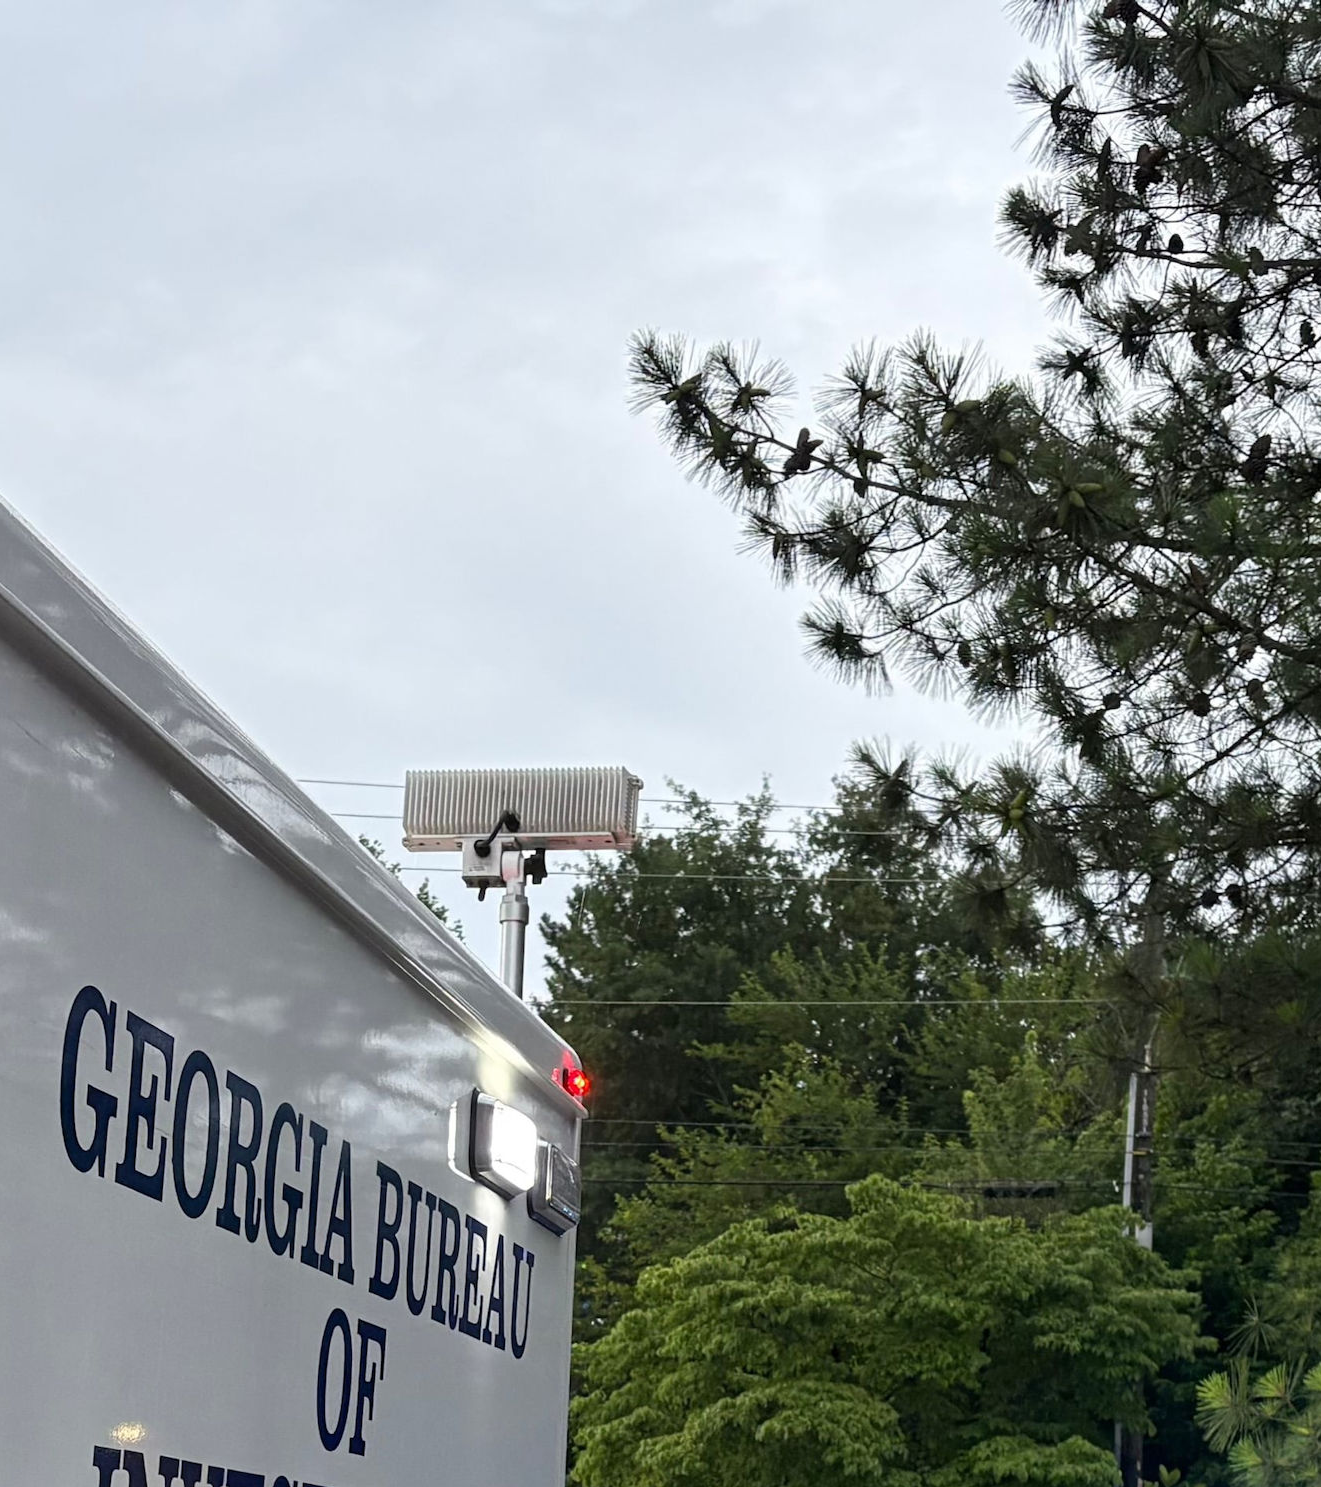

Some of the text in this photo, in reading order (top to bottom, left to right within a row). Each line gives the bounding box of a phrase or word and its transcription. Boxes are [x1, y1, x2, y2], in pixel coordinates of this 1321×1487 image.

[60, 985, 535, 1359] GEORGIA BUREAU
[317, 1308, 386, 1456] OF
